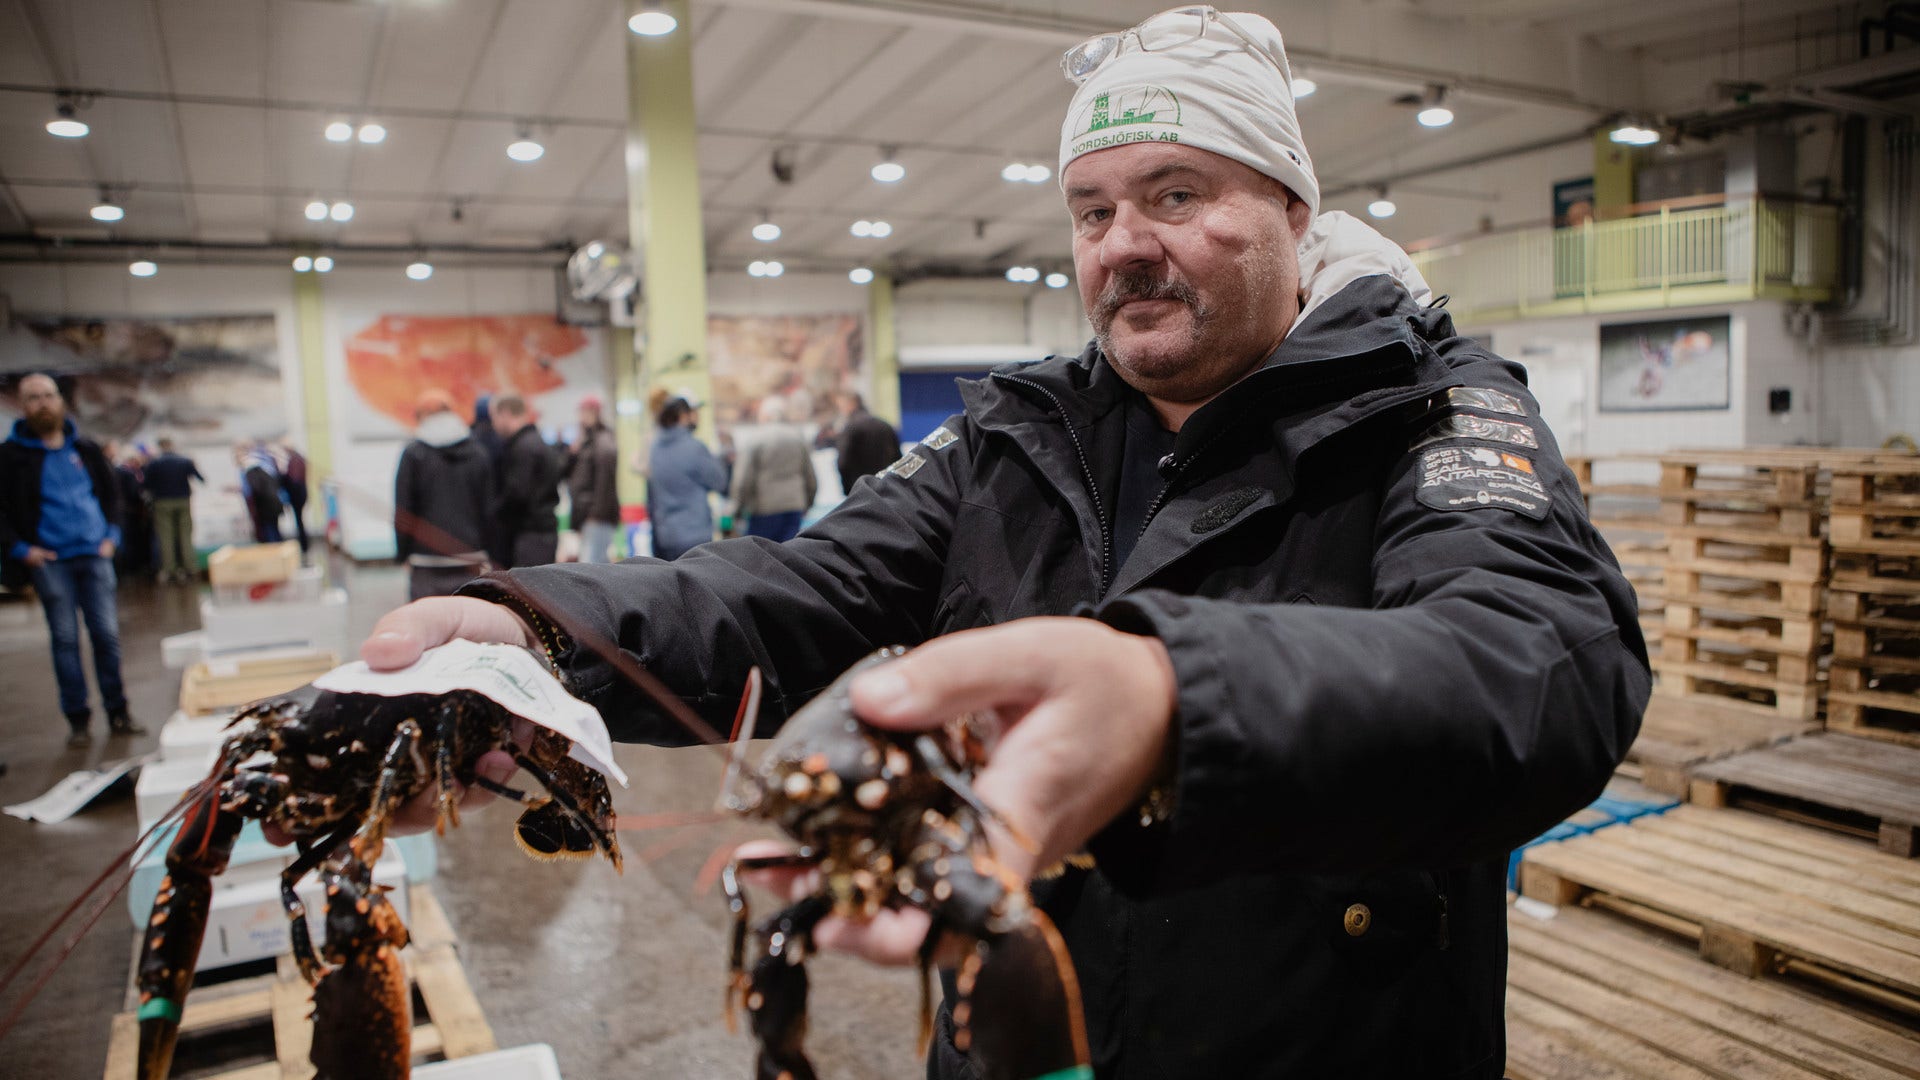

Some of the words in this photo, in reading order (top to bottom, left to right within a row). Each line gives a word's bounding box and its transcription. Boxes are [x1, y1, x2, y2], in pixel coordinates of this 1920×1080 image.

[1071, 131, 1153, 155] NORDSJÖFISK
[1159, 132, 1178, 143] AB
[1422, 469, 1544, 492] ANTARCTICA
[1424, 463, 1470, 480] SAIL
